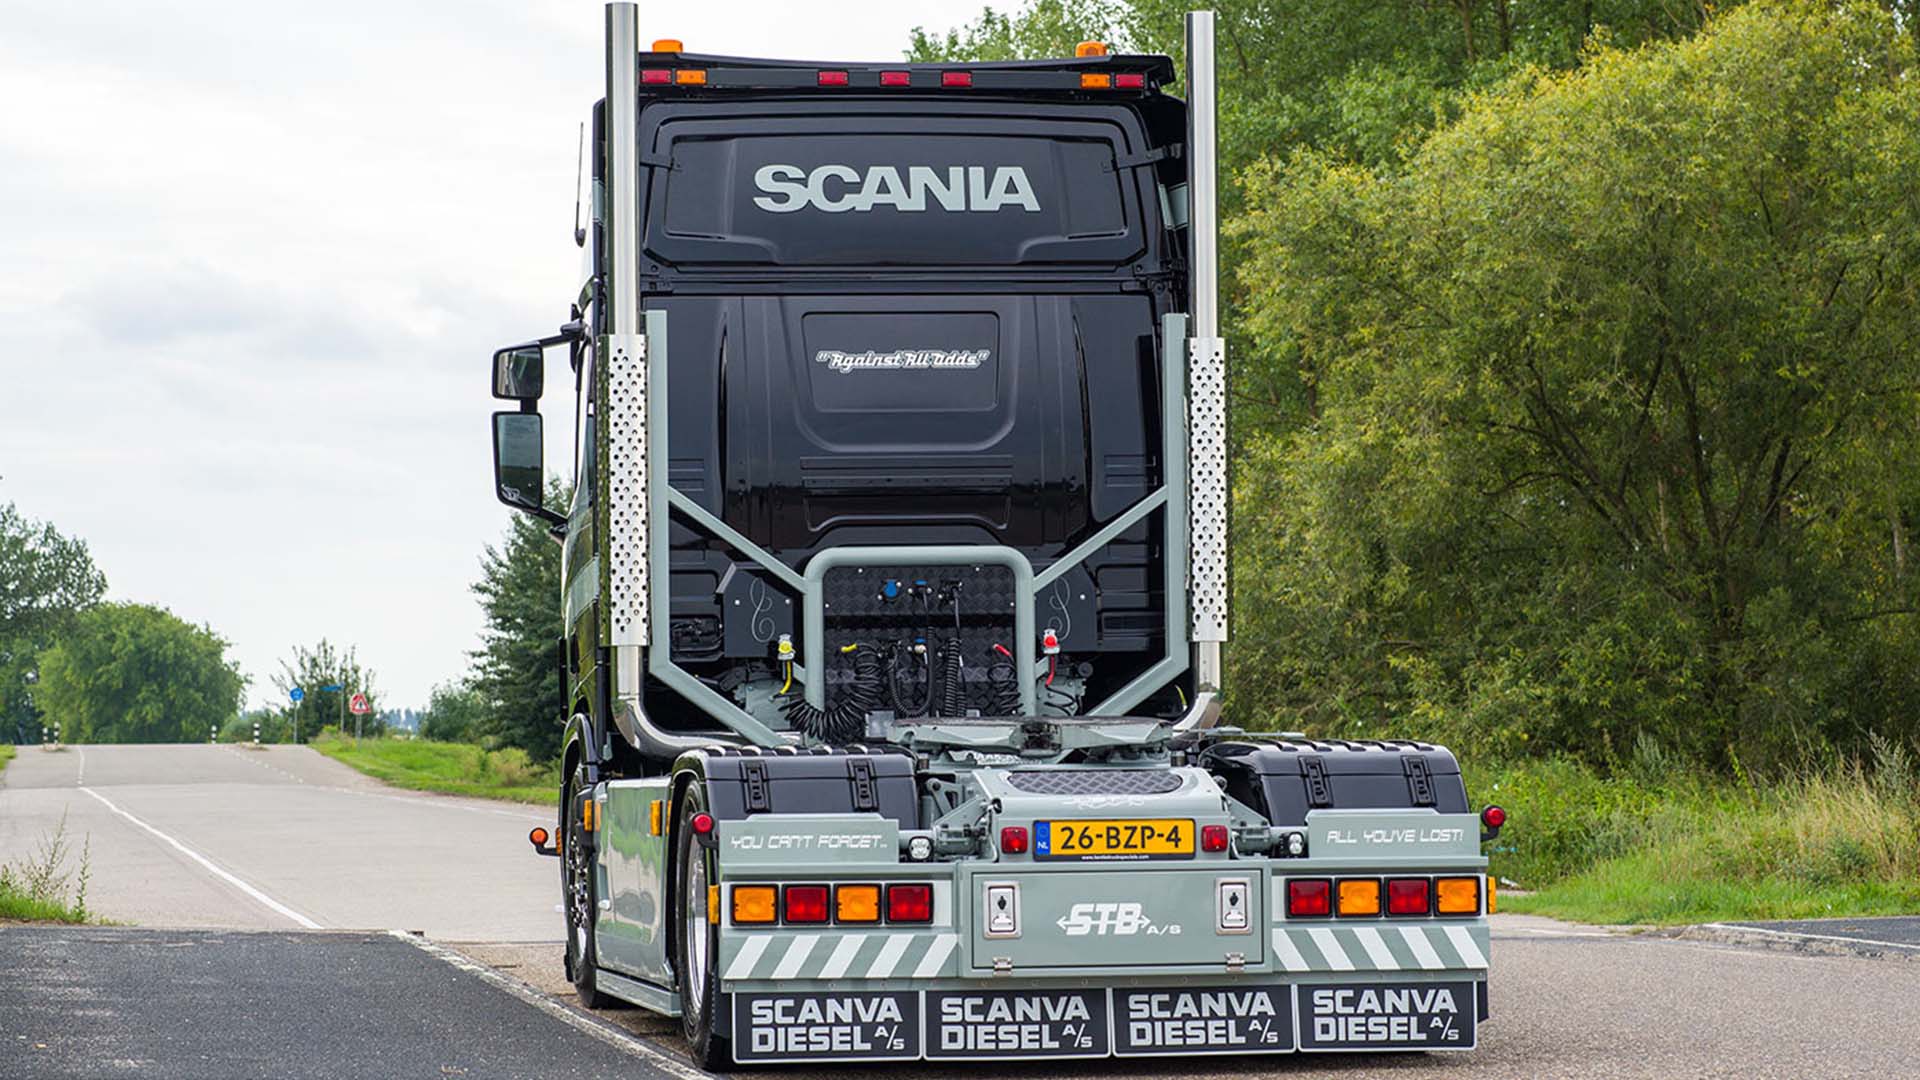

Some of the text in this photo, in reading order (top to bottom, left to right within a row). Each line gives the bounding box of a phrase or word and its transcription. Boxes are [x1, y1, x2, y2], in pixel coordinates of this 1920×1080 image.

[753, 164, 1041, 213] SCANIA
[903, 350, 929, 368] All
[731, 835, 764, 849] YOU
[1037, 842, 1049, 850] NL
[1060, 825, 1182, 850] 26-BZP-4
[1327, 830, 1357, 844] ALL
[1420, 828, 1464, 843] LOST!
[1066, 903, 1182, 935] STB A/S
[751, 998, 903, 1025] SCANVA
[941, 996, 1091, 1023] SCANVA
[1128, 991, 1276, 1019] SCANVA
[1313, 989, 1458, 1014] SCANVA
[751, 1025, 905, 1053] DIESEL A/S
[941, 1023, 1093, 1050] DIESEL A/S
[1129, 1018, 1278, 1046] DIESEL A/S
[1314, 1016, 1460, 1041] DIESEL A/S
